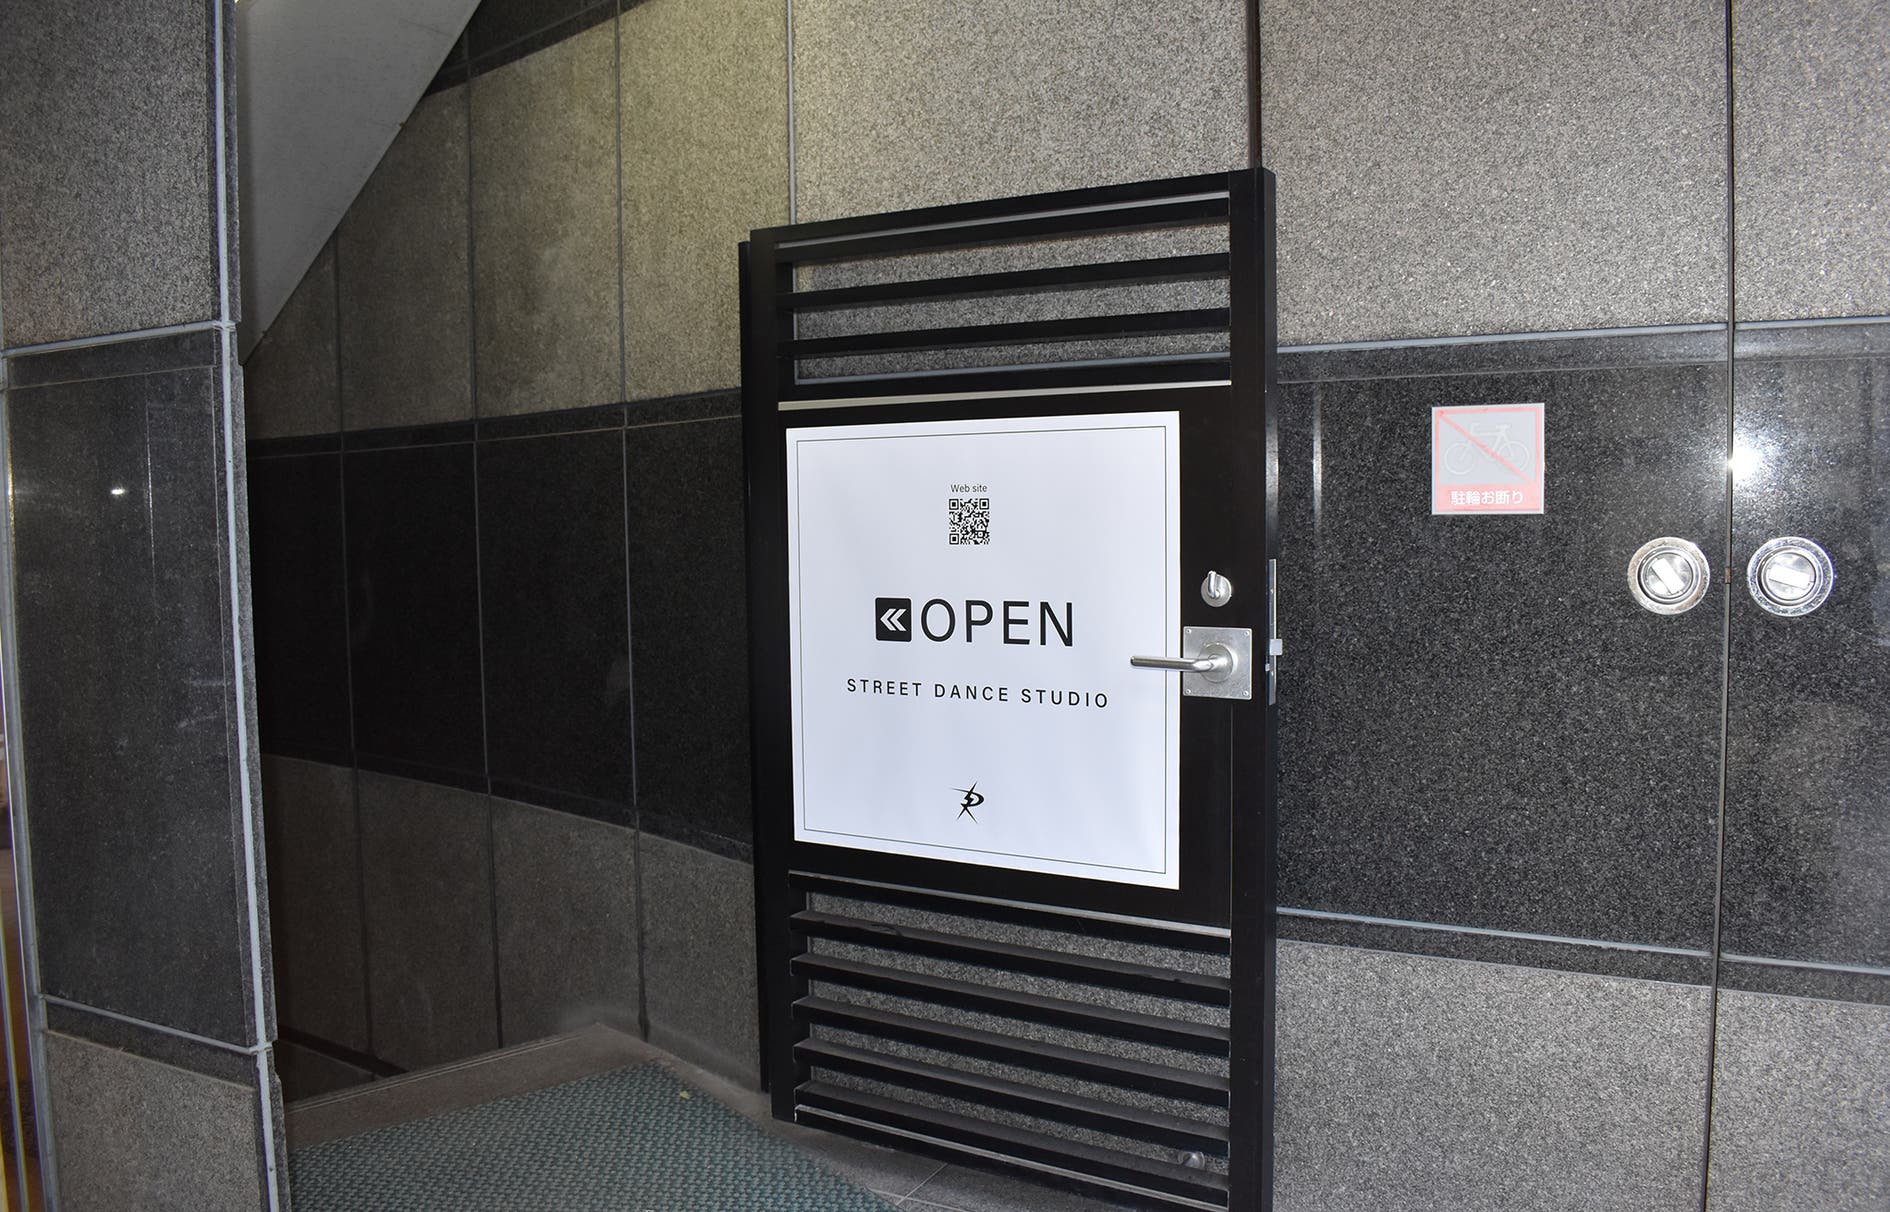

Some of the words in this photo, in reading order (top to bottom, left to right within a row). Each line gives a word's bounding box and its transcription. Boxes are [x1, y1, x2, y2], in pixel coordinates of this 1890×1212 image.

[950, 483, 970, 493] Web
[972, 483, 988, 493] site
[1450, 489, 1524, 506] 駐輪お断り
[920, 598, 1073, 648] OPEN
[847, 678, 922, 697] STREET
[934, 683, 1009, 702] DANCE
[1021, 688, 1108, 709] STUDIO
